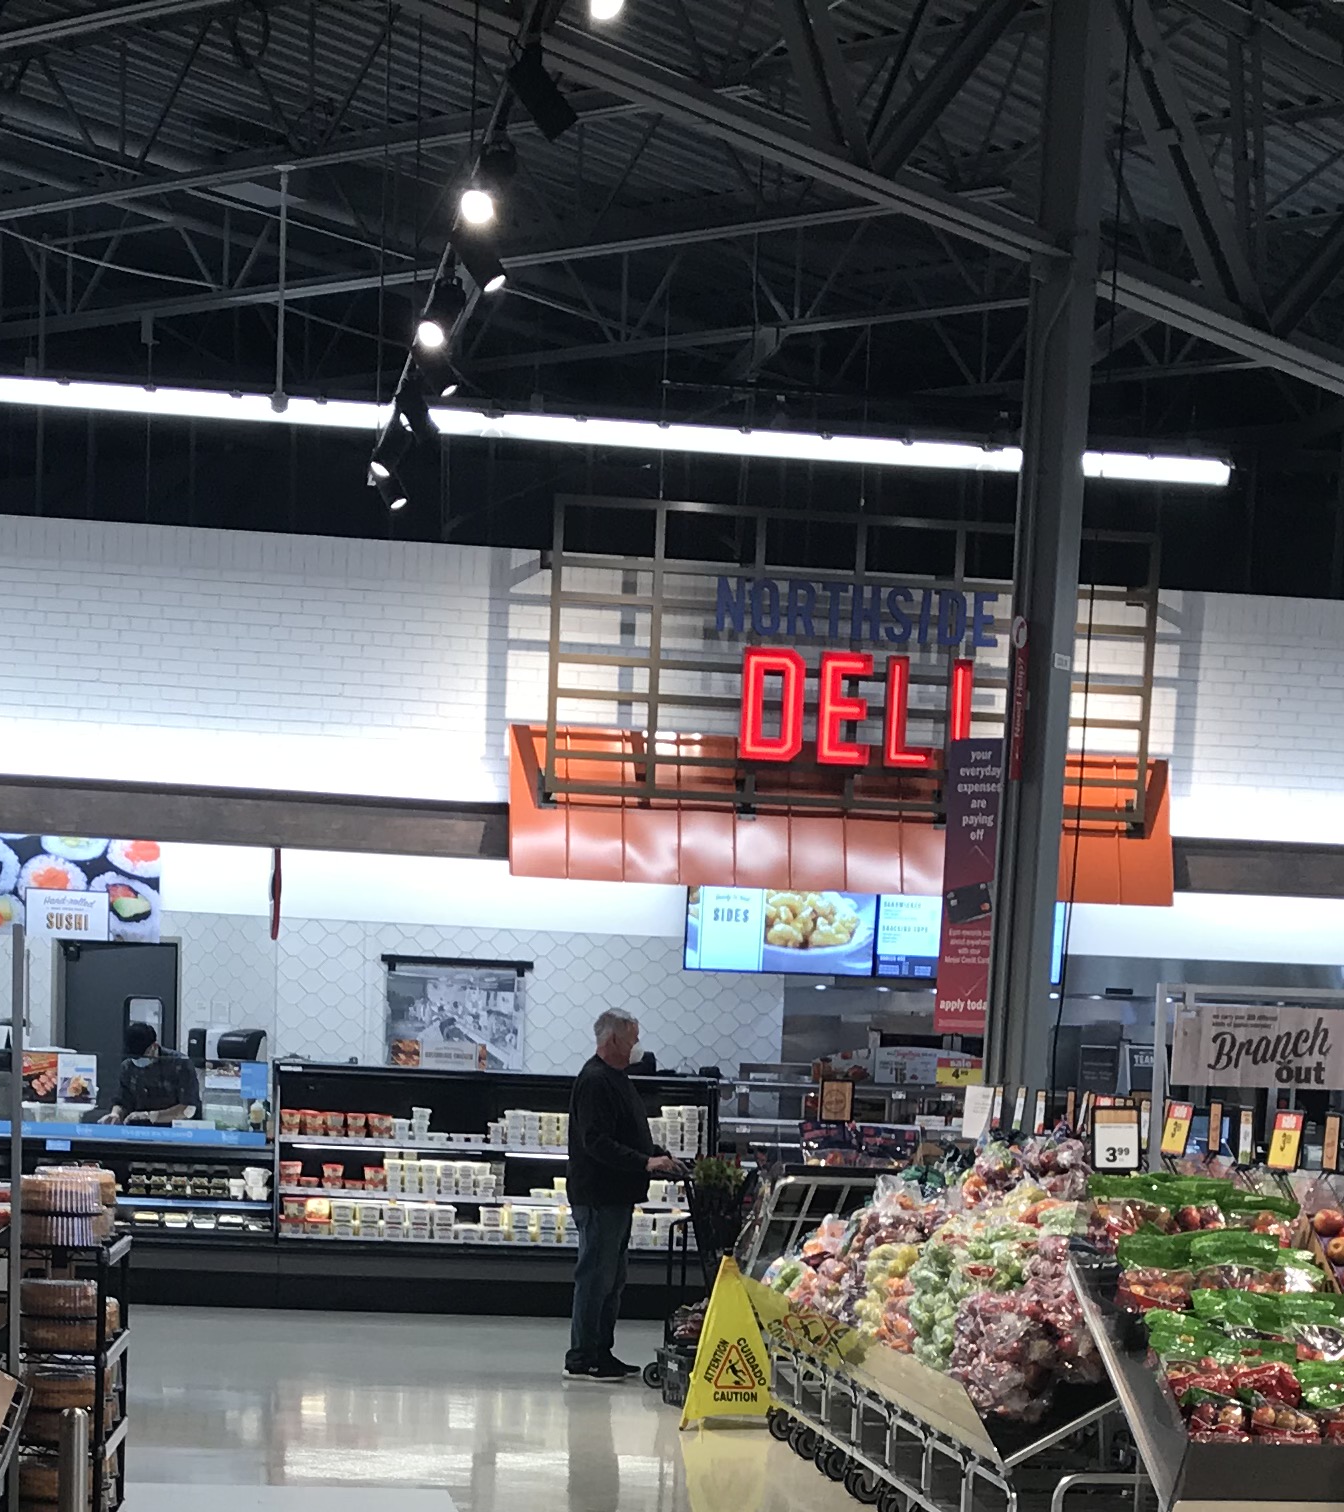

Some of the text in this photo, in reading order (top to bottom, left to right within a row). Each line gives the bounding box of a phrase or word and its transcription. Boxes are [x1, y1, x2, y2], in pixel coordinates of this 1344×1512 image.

[715, 575, 999, 649] NORTHSIDE
[738, 645, 973, 768] DELI
[970, 750, 993, 762] your
[959, 766, 1002, 780] everyday
[957, 783, 1002, 795] expenses
[970, 798, 987, 809] are
[962, 814, 994, 828] paying
[969, 829, 985, 841] off
[46, 912, 89, 931] SUSHI
[713, 907, 750, 923] SIDES
[939, 999, 988, 1013] apply toda
[1207, 1016, 1332, 1071] Branch
[1275, 1060, 1326, 1085] out
[703, 1337, 730, 1384] ATTENTION
[736, 1337, 767, 1387] CUIDADO
[713, 1391, 758, 1403] CAUTION
